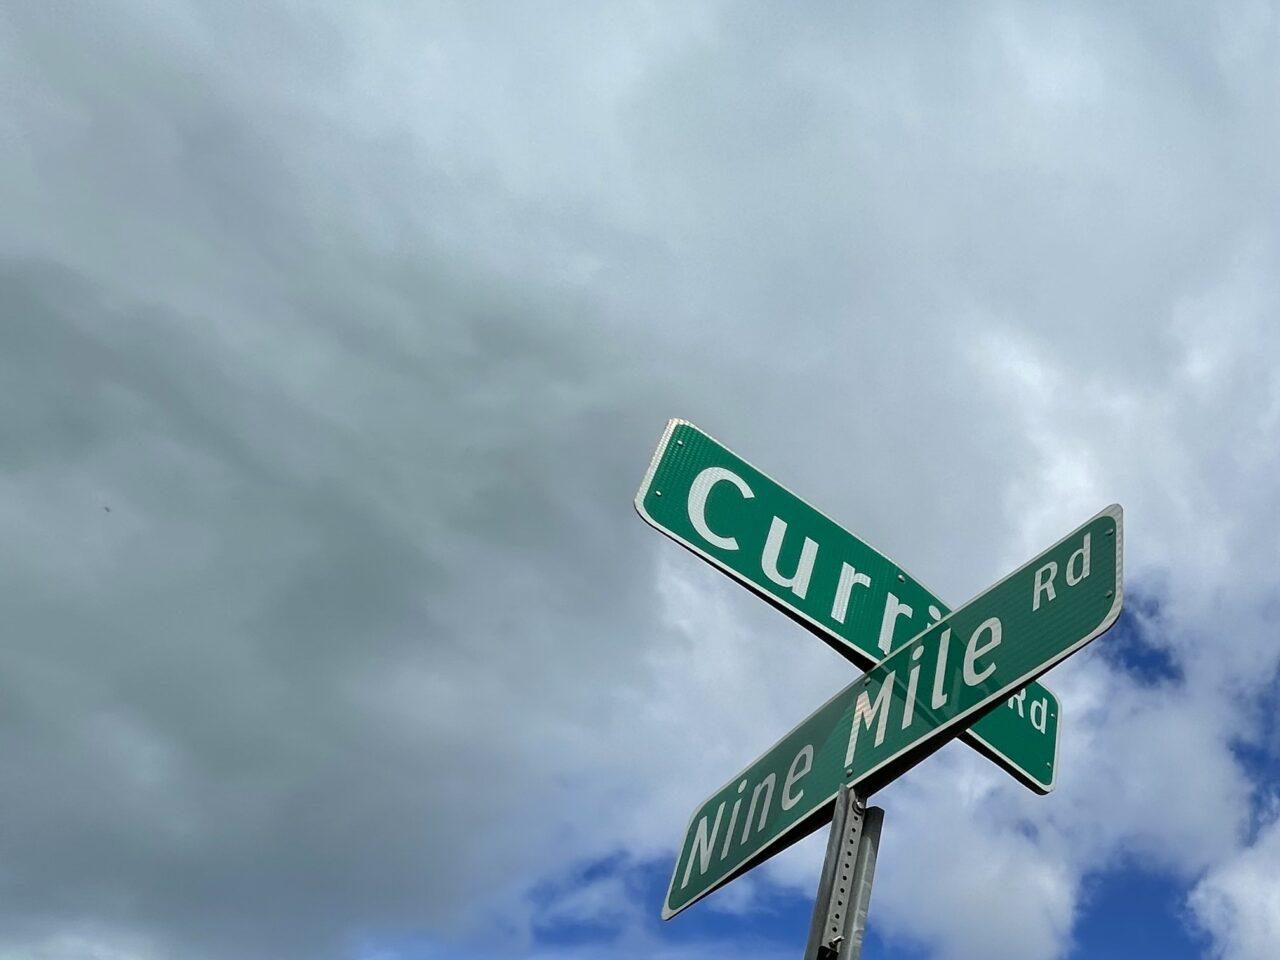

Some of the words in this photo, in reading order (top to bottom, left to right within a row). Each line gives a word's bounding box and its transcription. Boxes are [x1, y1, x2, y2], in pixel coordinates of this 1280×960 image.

[687, 466, 942, 656] Curr
[680, 744, 814, 889] Nine
[843, 616, 1002, 768] Mile
[1031, 533, 1092, 612] Rd
